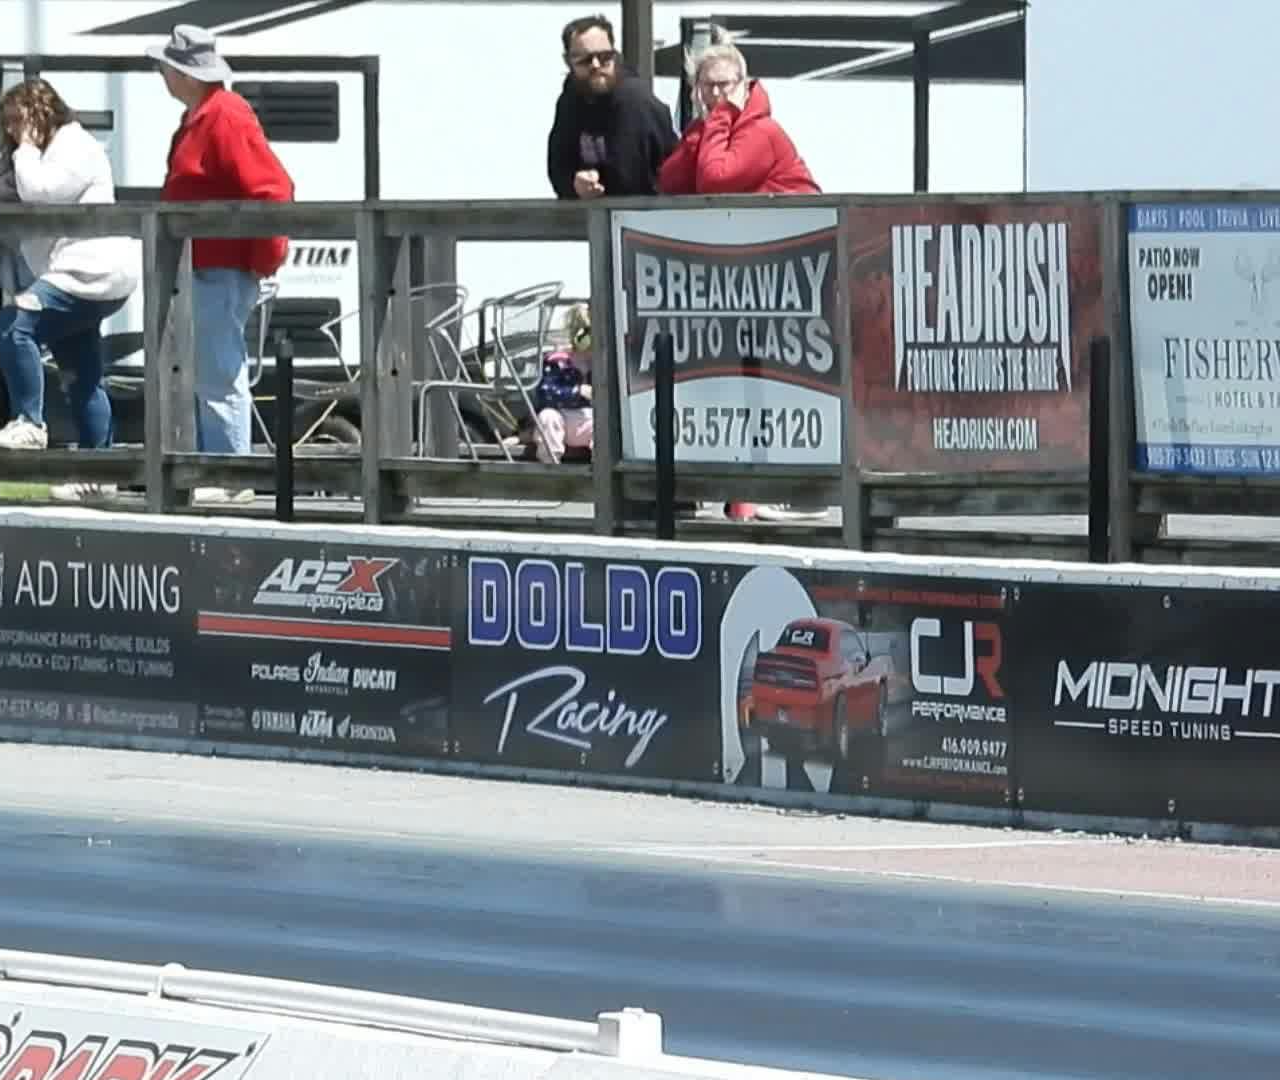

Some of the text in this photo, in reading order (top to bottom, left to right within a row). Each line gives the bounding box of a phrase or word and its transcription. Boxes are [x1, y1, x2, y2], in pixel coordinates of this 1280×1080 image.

[1139, 247, 1200, 268] PATIO NOW
[635, 250, 831, 317] BREAKAWAY
[1147, 272, 1193, 302] OPEN!
[892, 224, 1071, 391] HEADRUSH
[639, 317, 834, 373] AUTO GLASS
[907, 348, 1059, 391] FORTUNE FAVOURS THE BRAVE
[1215, 391, 1253, 409] HOTEL
[933, 416, 1038, 451] HEADRUSH.COM
[15, 559, 181, 615] AD TUNING
[259, 555, 401, 595] APEX
[305, 593, 385, 615] apexcycle.ca
[467, 556, 703, 661] DOLDO
[251, 649, 398, 692] POLARIS Indian DUCATI
[910, 617, 1005, 698] CJR
[1054, 659, 1280, 718] MIDNIGHT
[299, 709, 334, 739] KTM
[350, 723, 398, 743] HONDA
[482, 664, 670, 769] Racing
[1107, 717, 1232, 741] SPEED TUNING
